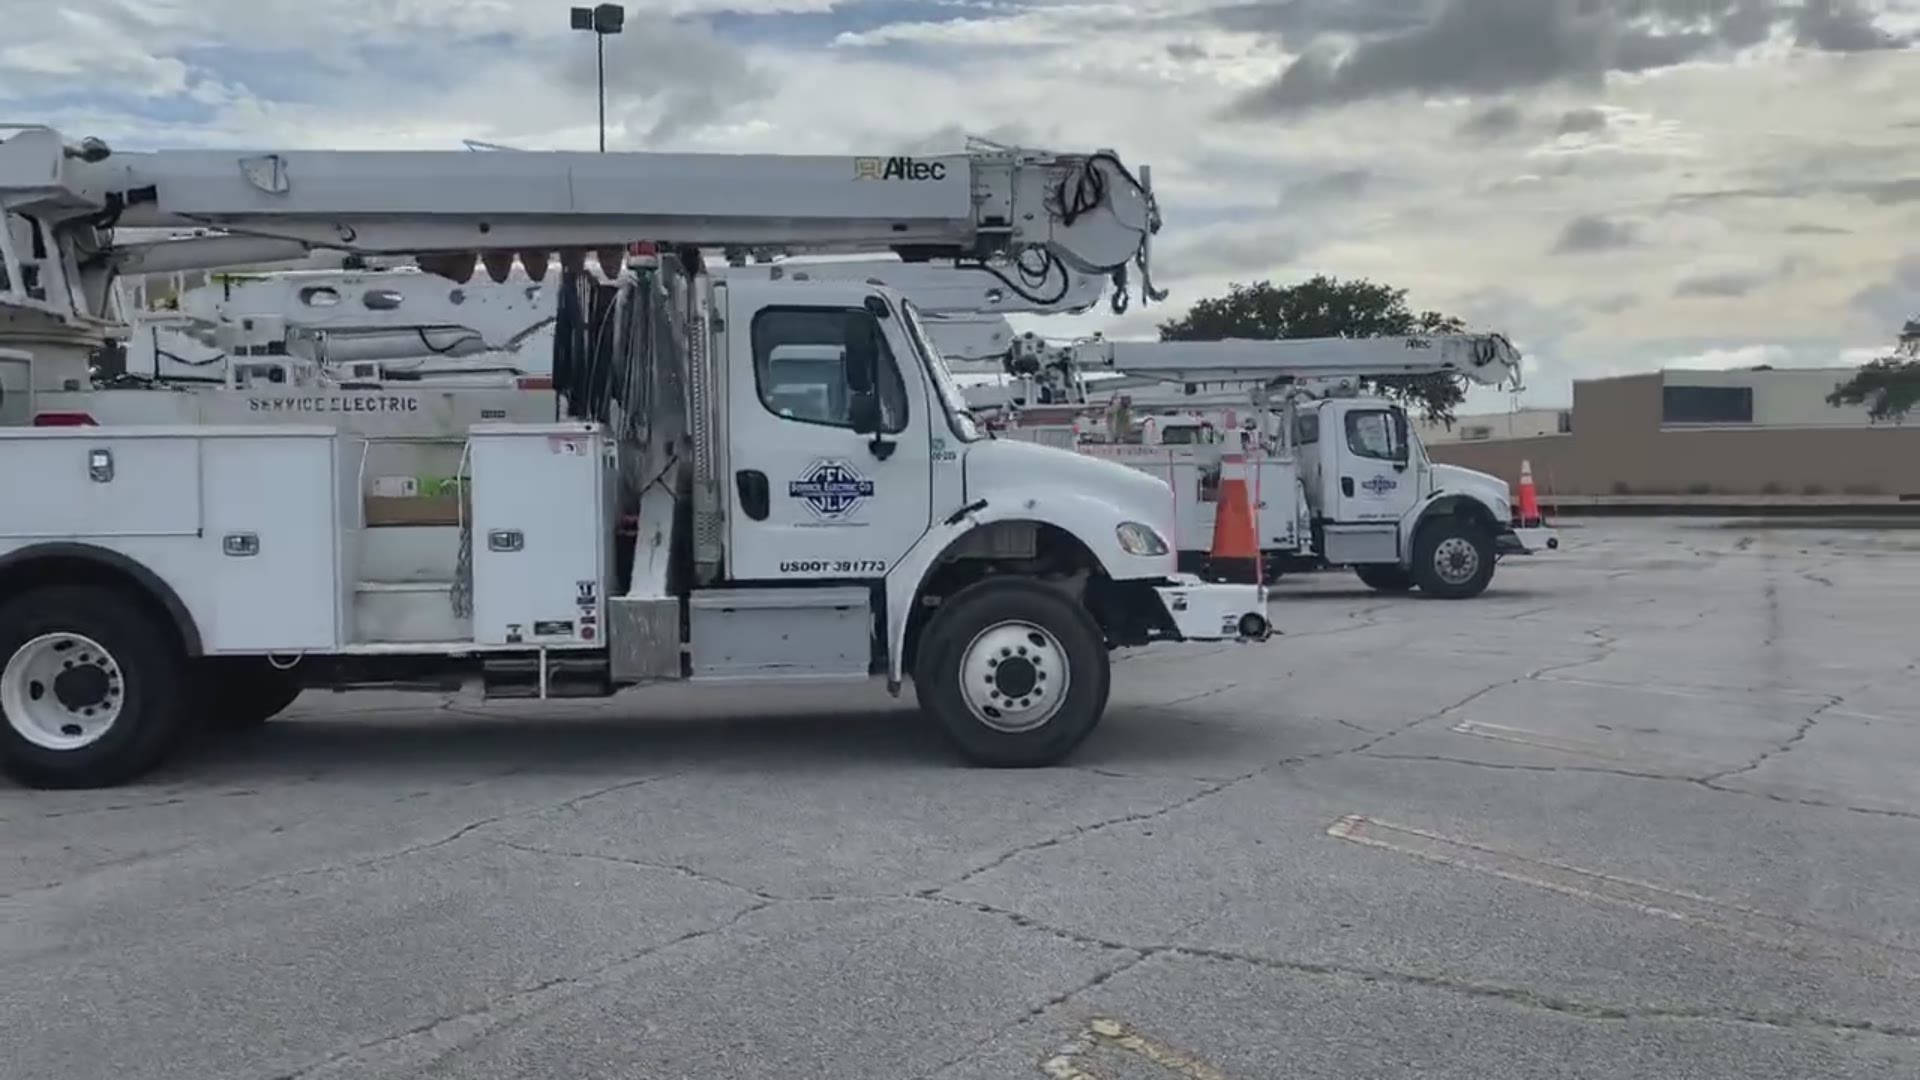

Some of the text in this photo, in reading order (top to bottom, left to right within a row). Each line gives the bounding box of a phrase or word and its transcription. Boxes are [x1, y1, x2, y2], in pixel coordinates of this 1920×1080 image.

[883, 156, 946, 180] Altec
[249, 397, 418, 412] SERVICE ELECTRIC
[833, 561, 886, 572] 391773
